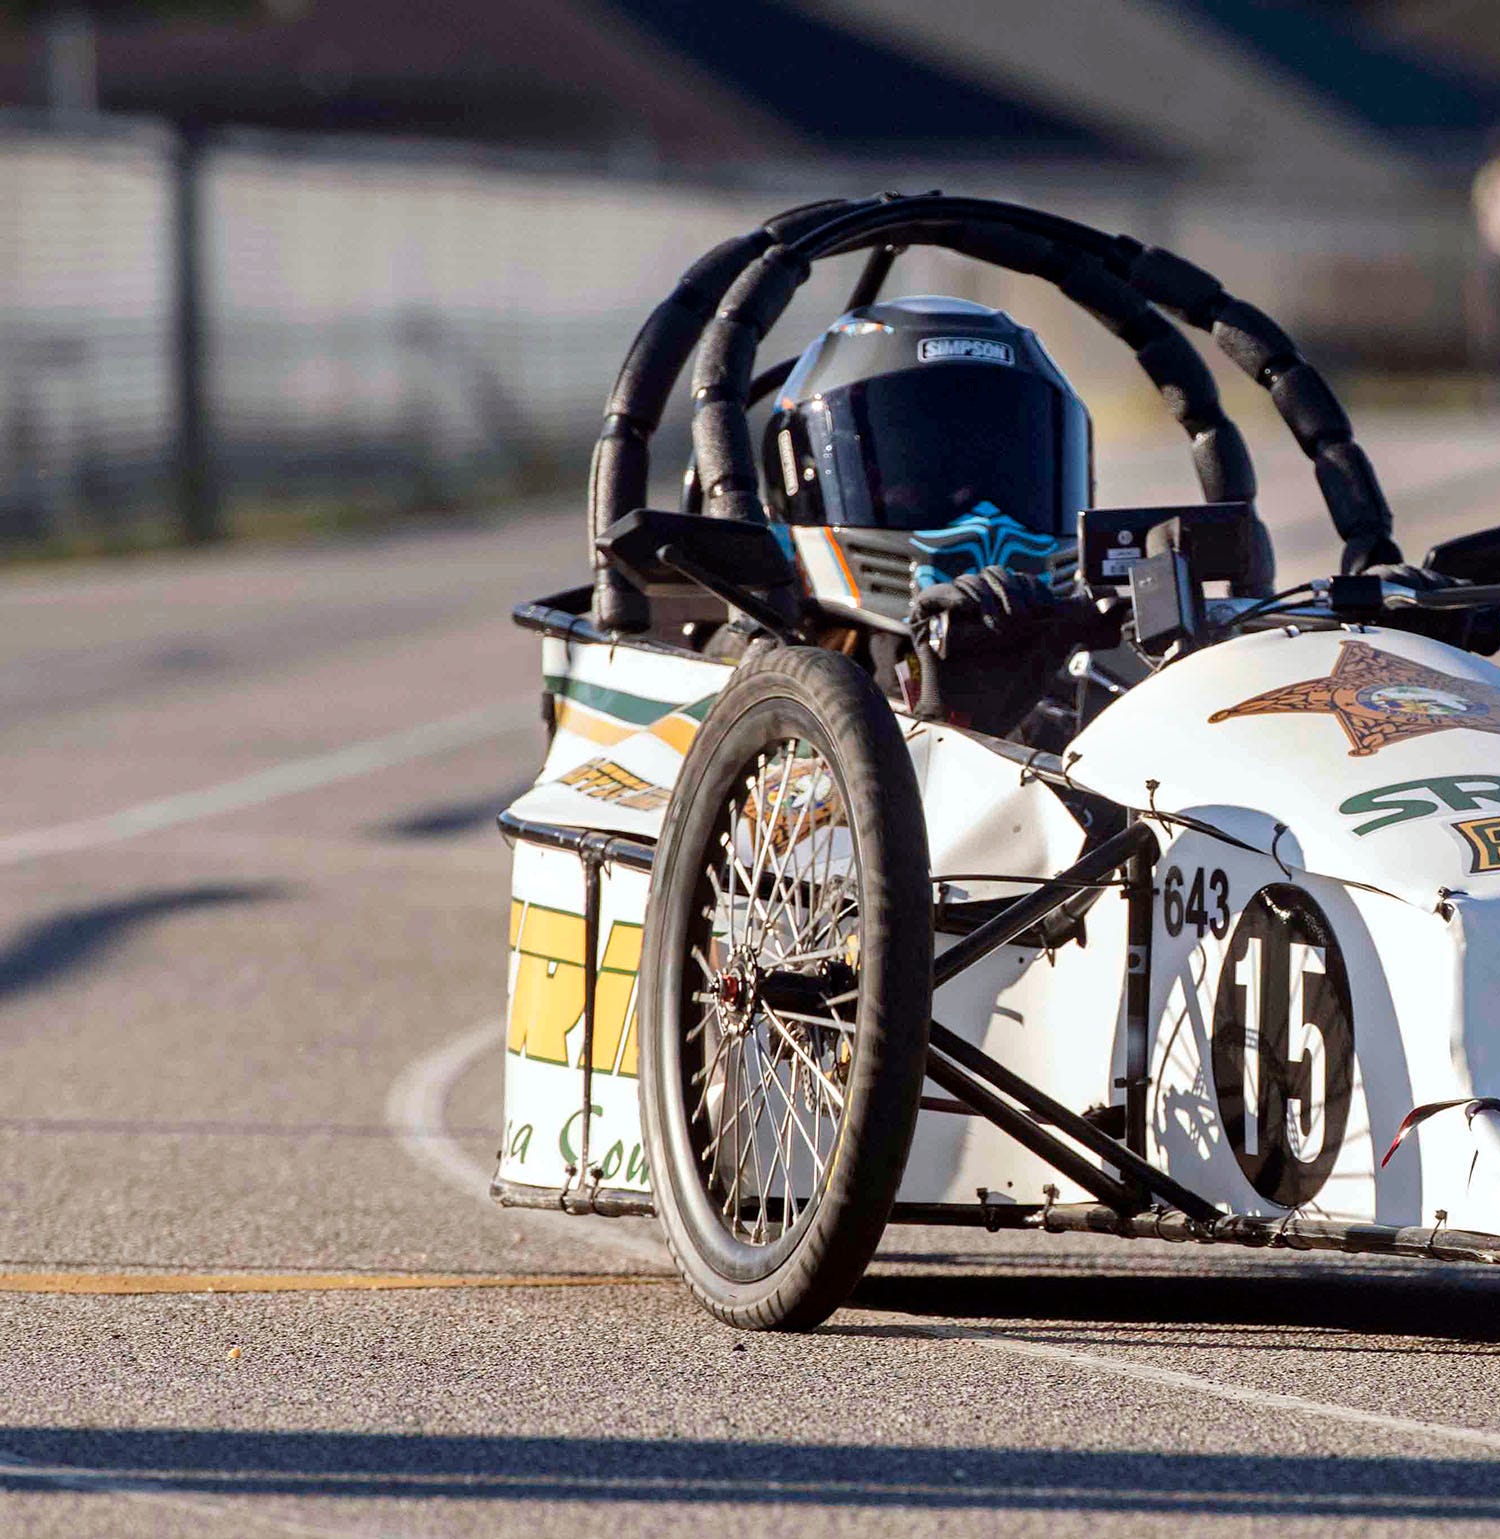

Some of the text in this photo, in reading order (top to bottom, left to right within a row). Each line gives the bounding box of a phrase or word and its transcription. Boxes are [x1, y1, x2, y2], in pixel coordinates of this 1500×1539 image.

[924, 339, 1008, 361] SIMPSON
[1164, 865, 1230, 940] 643
[1235, 937, 1327, 1163] 15
